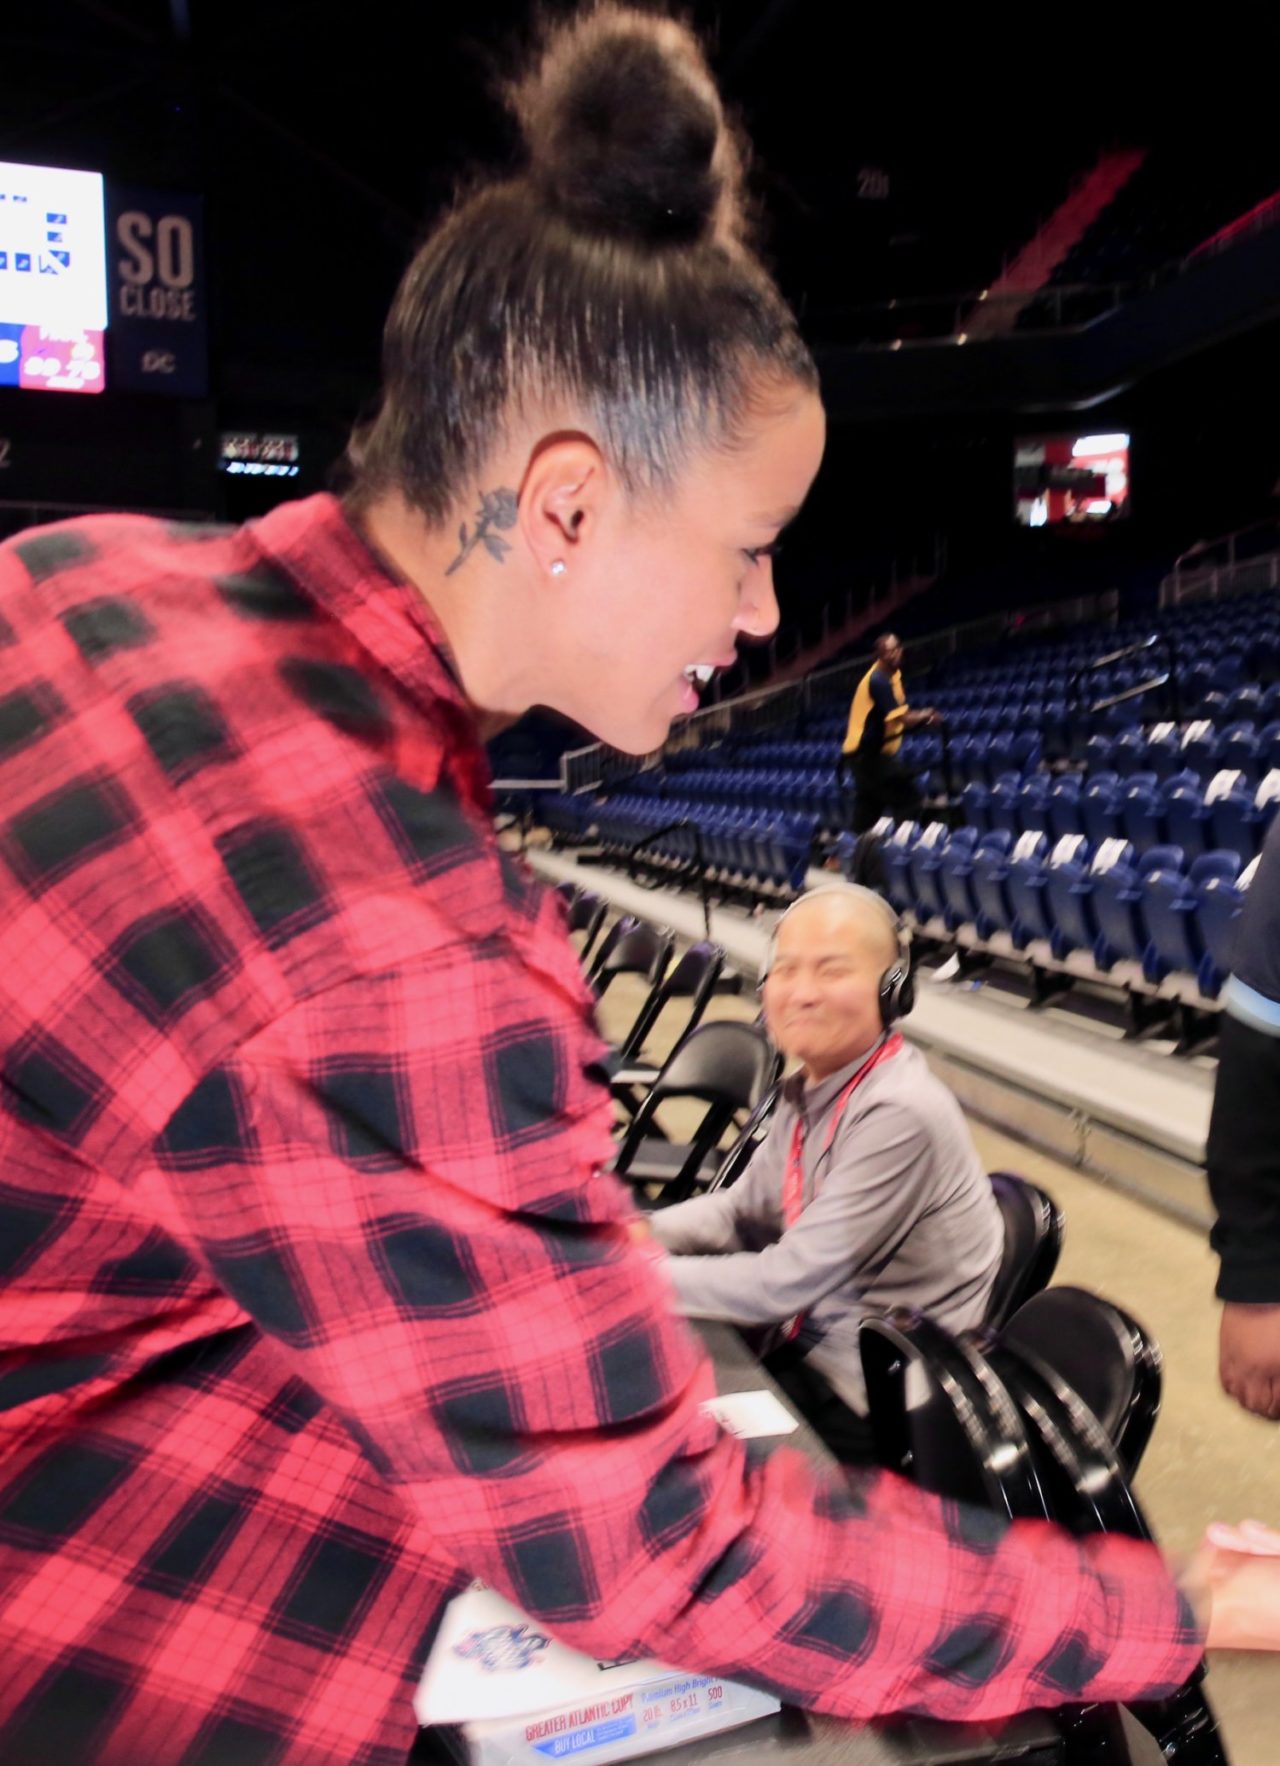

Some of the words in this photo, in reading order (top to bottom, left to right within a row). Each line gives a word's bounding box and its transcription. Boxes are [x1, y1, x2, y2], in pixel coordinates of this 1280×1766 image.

[117, 210, 194, 289] SO
[120, 285, 196, 320] CLOSE
[708, 1685, 722, 1701] 500
[525, 1713, 567, 1741] GREATER
[569, 1701, 610, 1728] ATLANTIC
[554, 1736, 572, 1754] BUY
[571, 1729, 596, 1749] LOCAL
